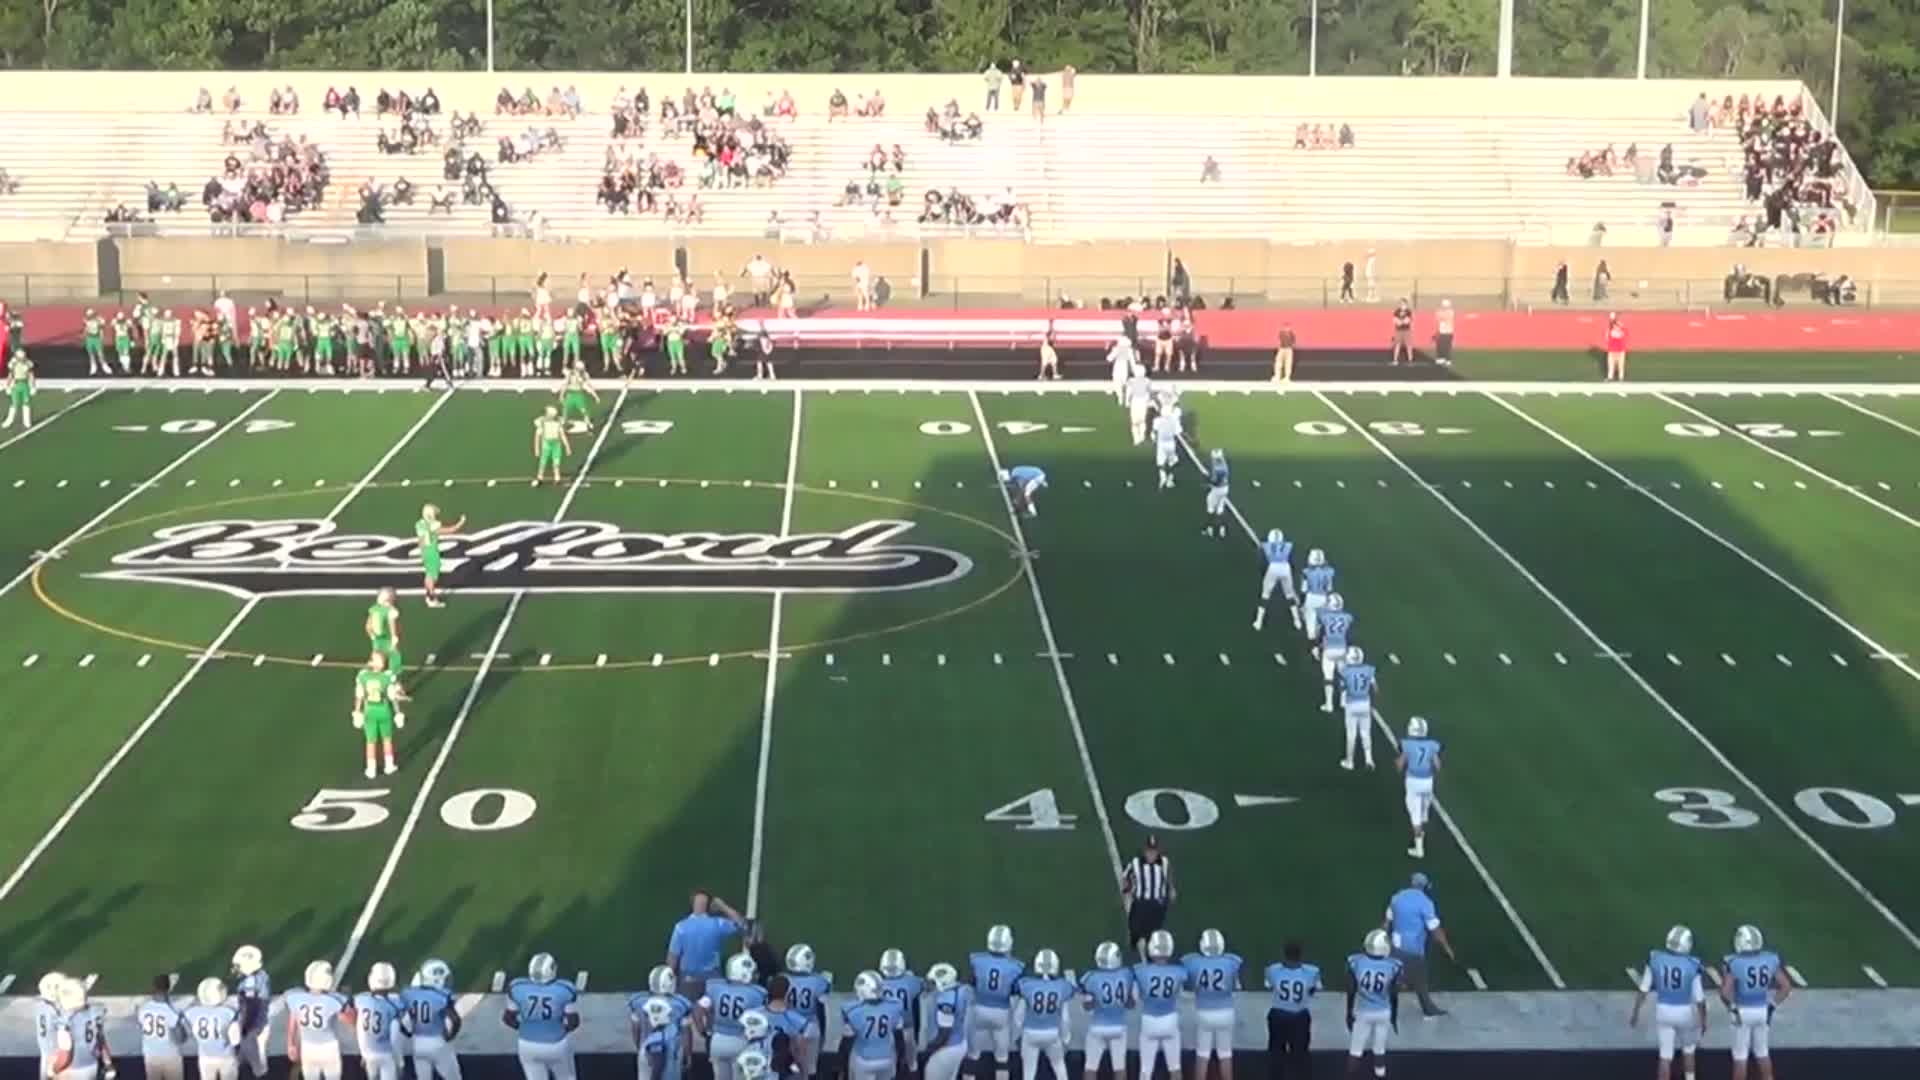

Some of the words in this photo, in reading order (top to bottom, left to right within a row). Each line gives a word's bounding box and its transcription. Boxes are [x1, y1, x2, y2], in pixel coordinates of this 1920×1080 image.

[110, 518, 916, 572] Bedford
[1327, 616, 1345, 635] 22
[1414, 746, 1427, 768] 7
[988, 967, 1000, 992] 8
[1149, 975, 1175, 999] 28
[1199, 968, 1225, 992] 42
[1360, 969, 1385, 993] 46
[1663, 964, 1682, 990] 19
[1746, 964, 1769, 990] 56
[1033, 990, 1059, 1014] 88
[1101, 980, 1125, 1005] 34
[1279, 979, 1304, 1002] 59
[299, 1003, 323, 1029] 35
[527, 994, 553, 1020] 75
[718, 993, 746, 1021] 66
[143, 1013, 167, 1038] 36
[197, 1016, 220, 1041] 81
[361, 1007, 382, 1034] 33
[865, 1014, 889, 1039] 76
